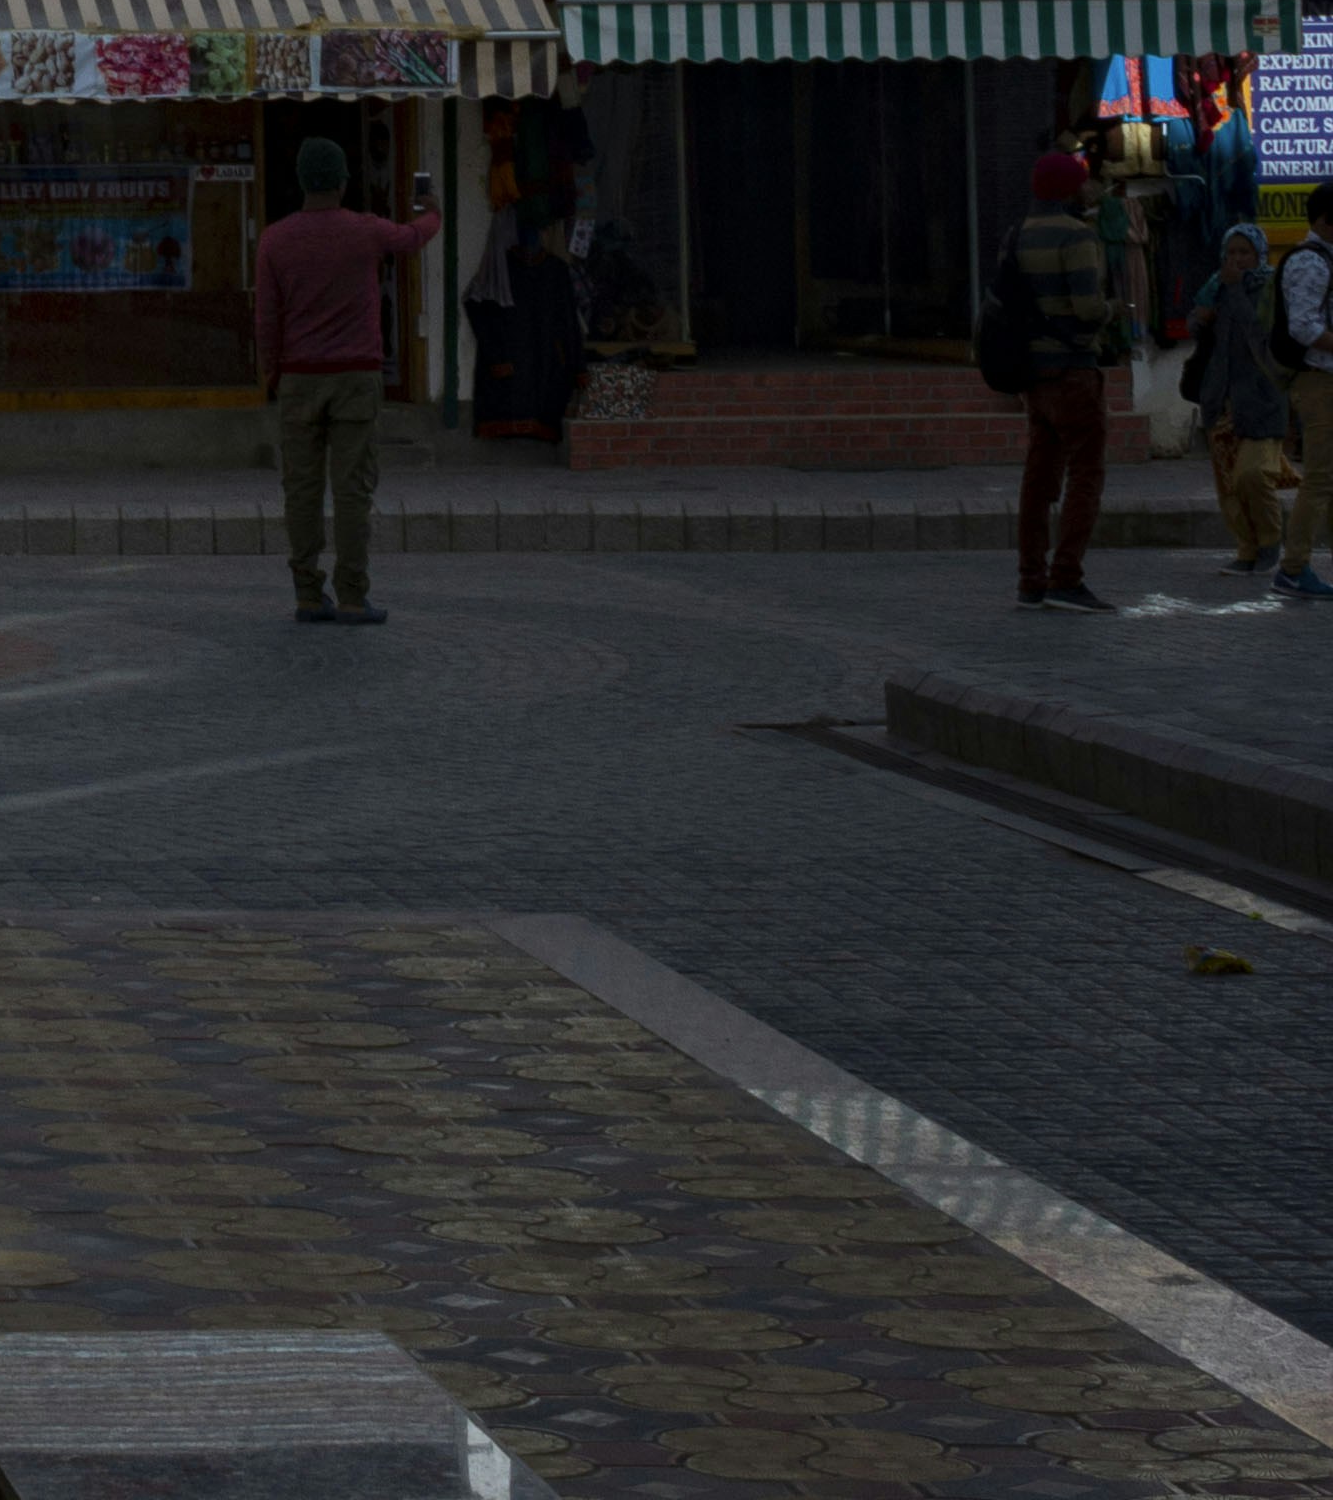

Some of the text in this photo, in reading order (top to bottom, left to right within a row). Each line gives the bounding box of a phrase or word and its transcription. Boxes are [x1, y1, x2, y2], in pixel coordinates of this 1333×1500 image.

[1302, 32, 1333, 49] KIN
[1259, 74, 1333, 92] RAFTING
[1260, 117, 1319, 134] CAMEL
[1256, 191, 1311, 219] MONE
